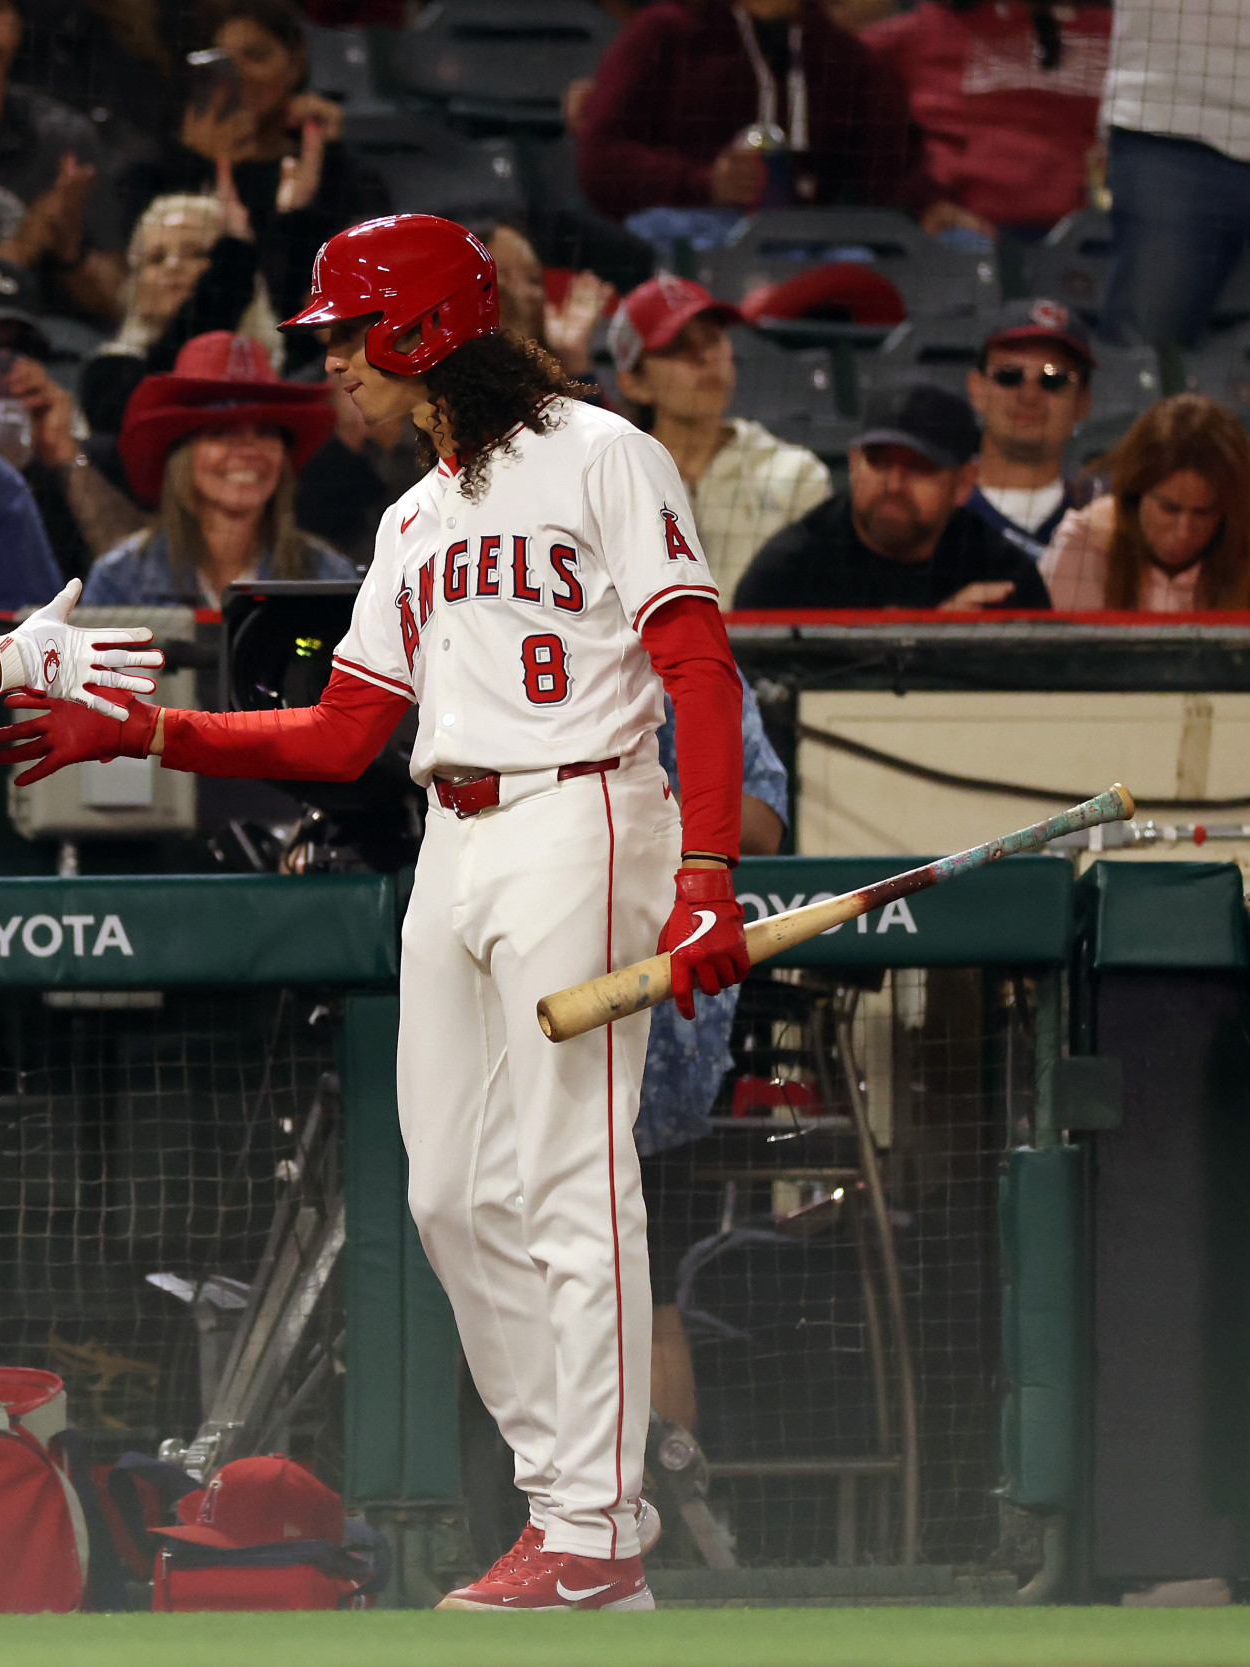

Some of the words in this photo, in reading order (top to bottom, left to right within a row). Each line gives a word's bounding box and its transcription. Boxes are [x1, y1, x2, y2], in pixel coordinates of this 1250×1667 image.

[659, 501, 699, 564] A
[394, 533, 587, 677] ANGELS
[520, 632, 573, 708] 8
